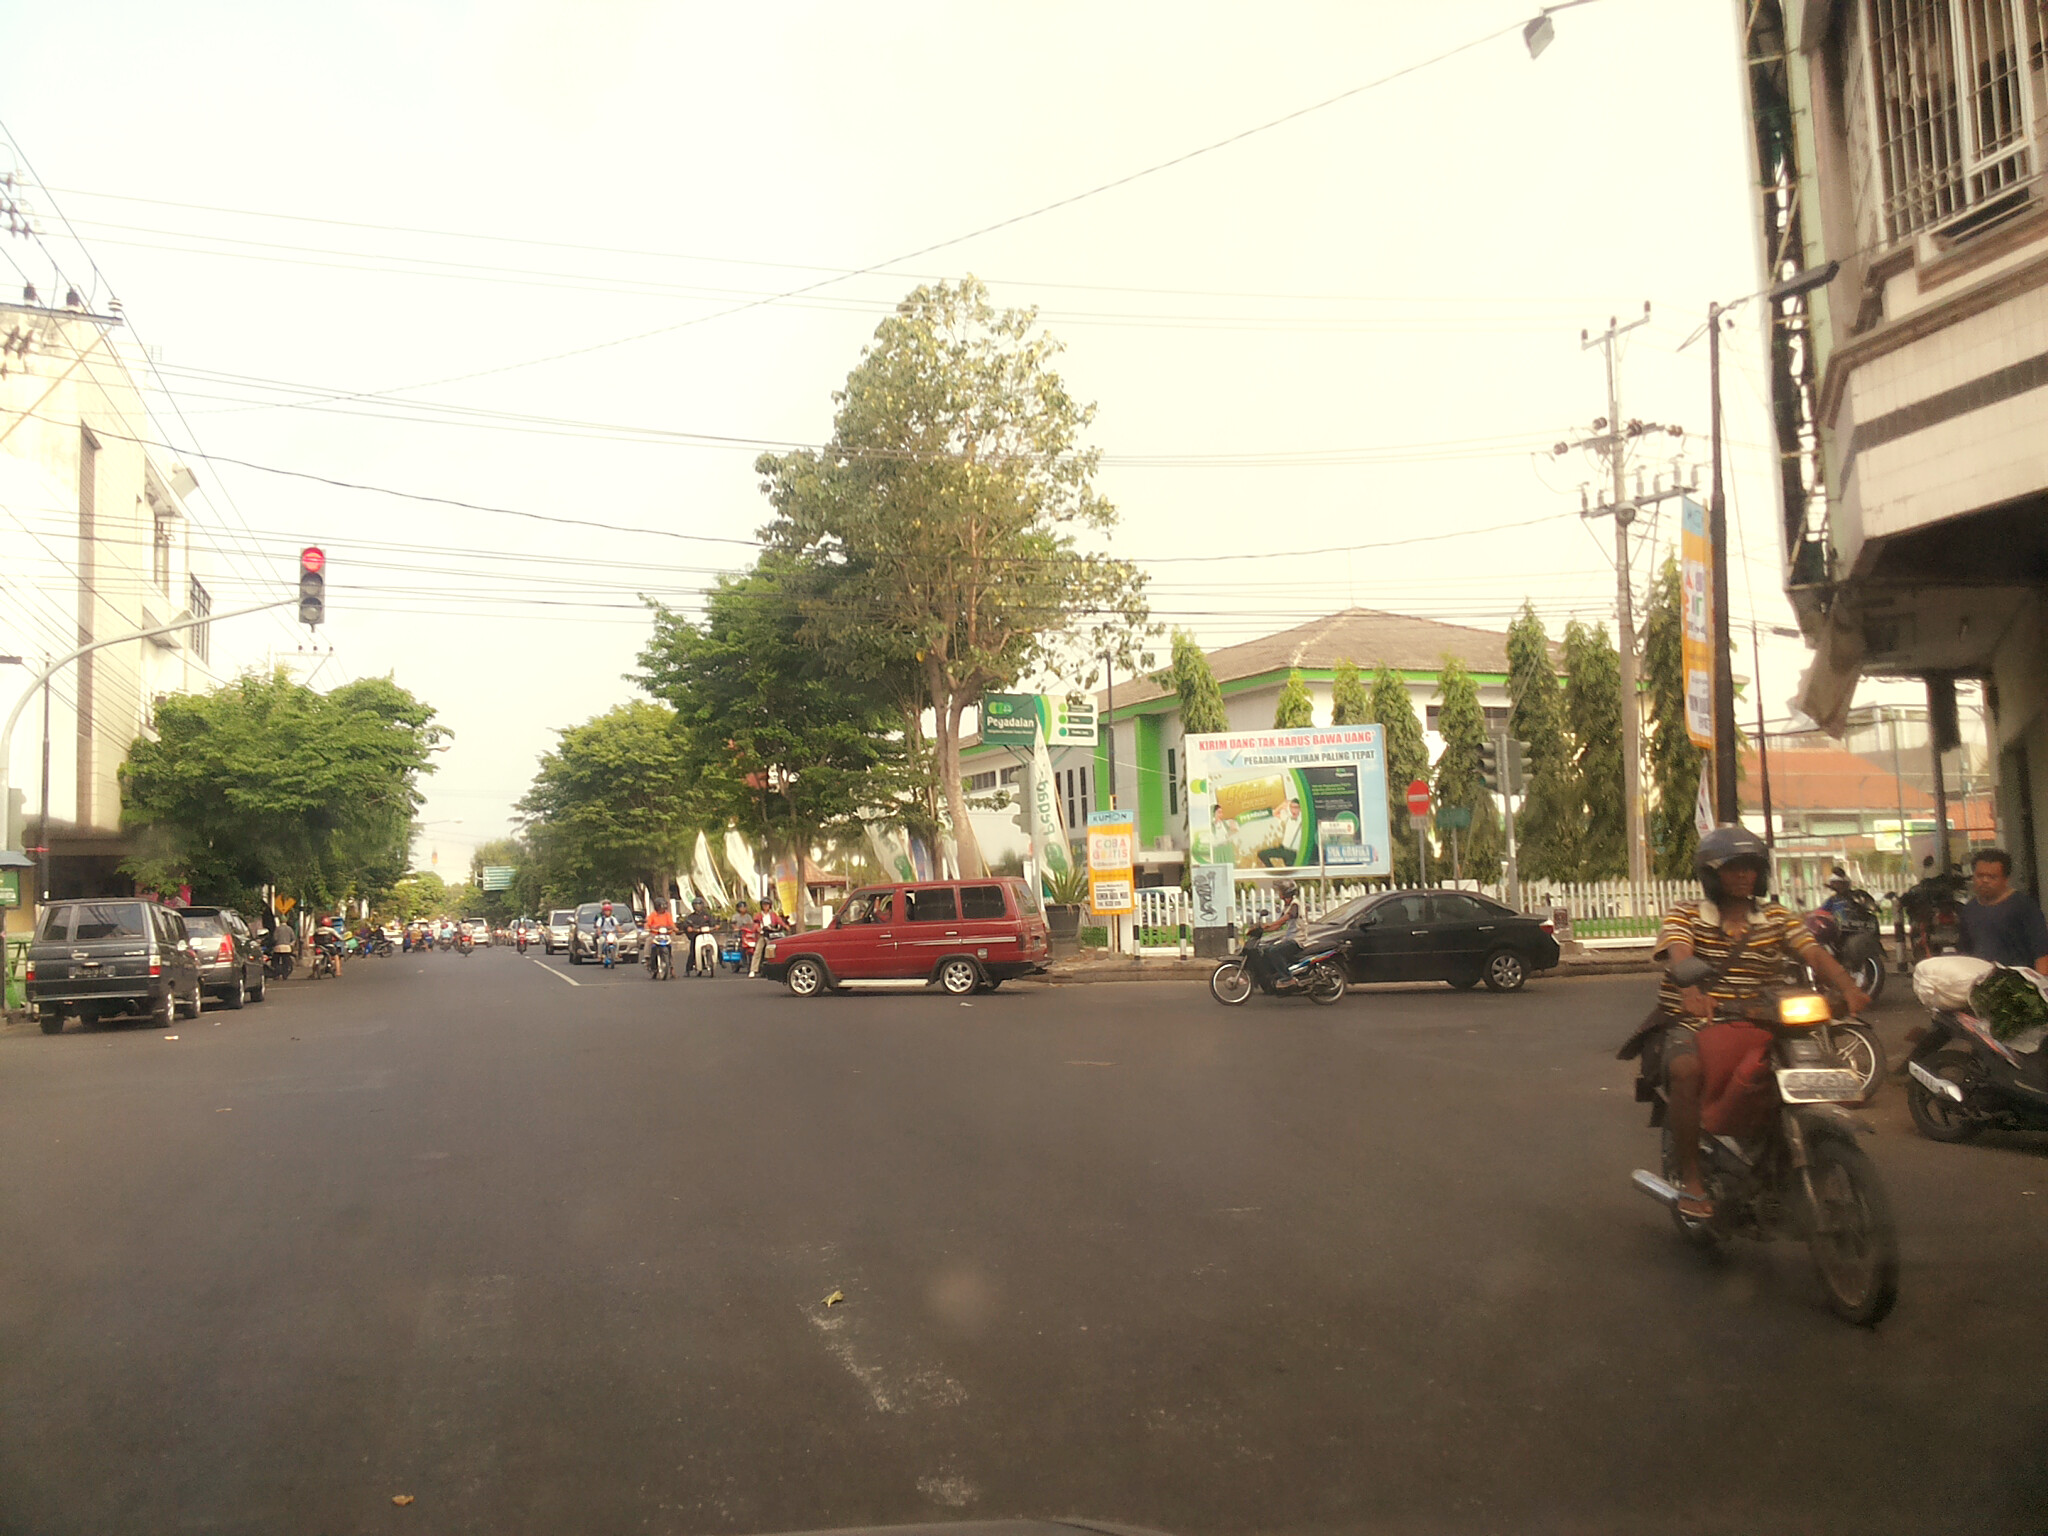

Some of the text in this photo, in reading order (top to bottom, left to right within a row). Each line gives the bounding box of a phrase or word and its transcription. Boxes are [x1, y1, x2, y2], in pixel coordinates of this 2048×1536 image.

[986, 716, 1034, 728] Pegadaian
[1199, 740, 1228, 751] KIRIM
[1230, 738, 1255, 749] UANG
[1257, 737, 1276, 748] TAK
[1278, 735, 1311, 747] HARUS
[1313, 733, 1343, 745] BAWA
[1244, 750, 1375, 765] PEGADAIAN PILIHAN PALING TEPAT
[1092, 812, 1127, 822] KUMON
[1095, 838, 1127, 849] COBA
